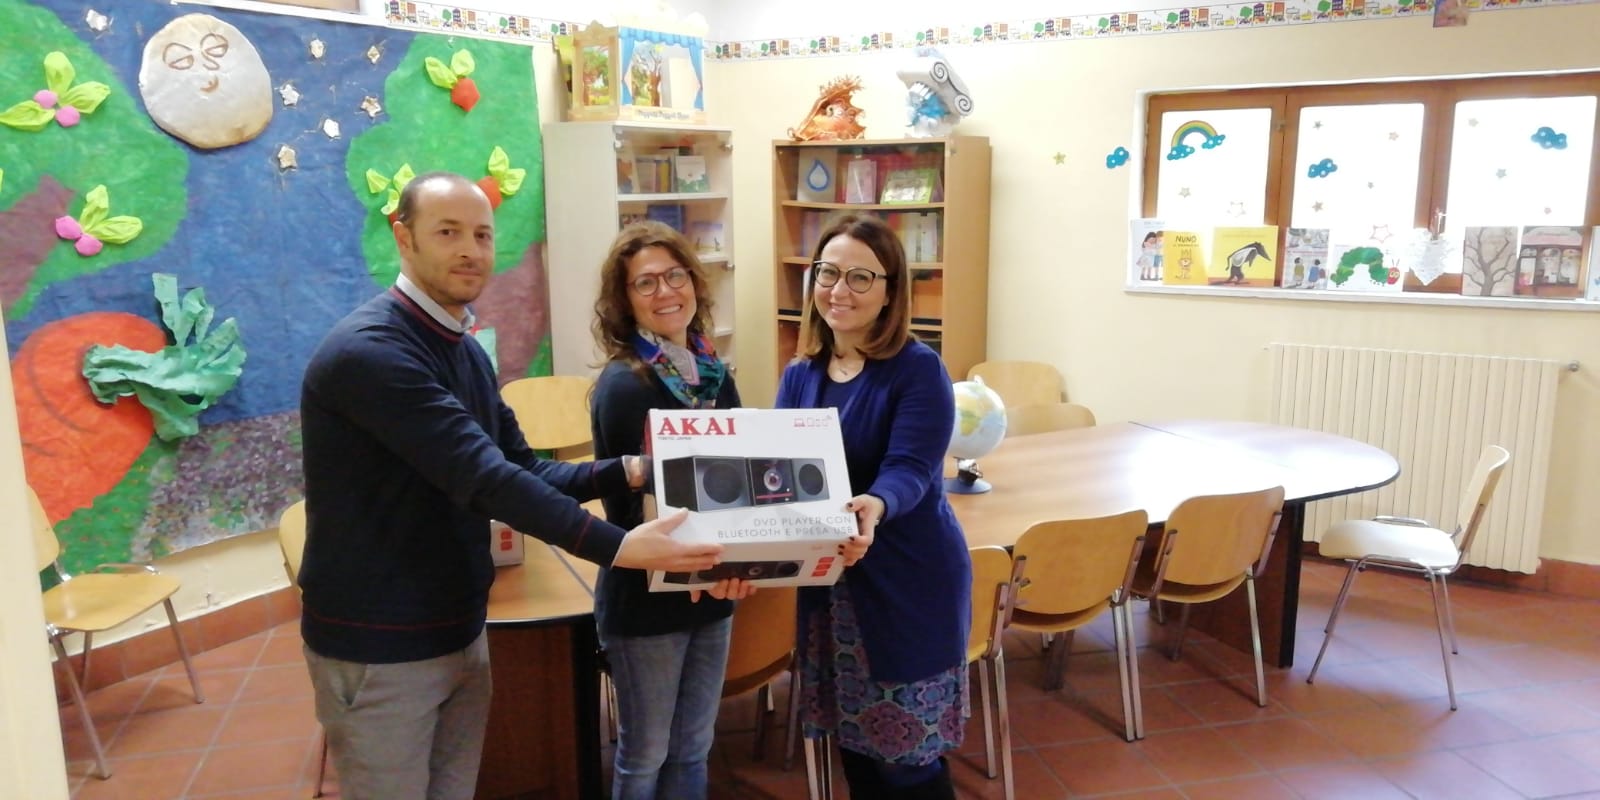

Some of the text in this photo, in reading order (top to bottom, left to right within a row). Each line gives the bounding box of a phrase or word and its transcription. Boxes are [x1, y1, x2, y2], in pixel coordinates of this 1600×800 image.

[1175, 234, 1198, 244] NUNO
[657, 416, 737, 436] AKAI
[753, 515, 852, 527] DVD PLAYER CON
[717, 525, 853, 539] BLUETOOTH E PRESA USB
